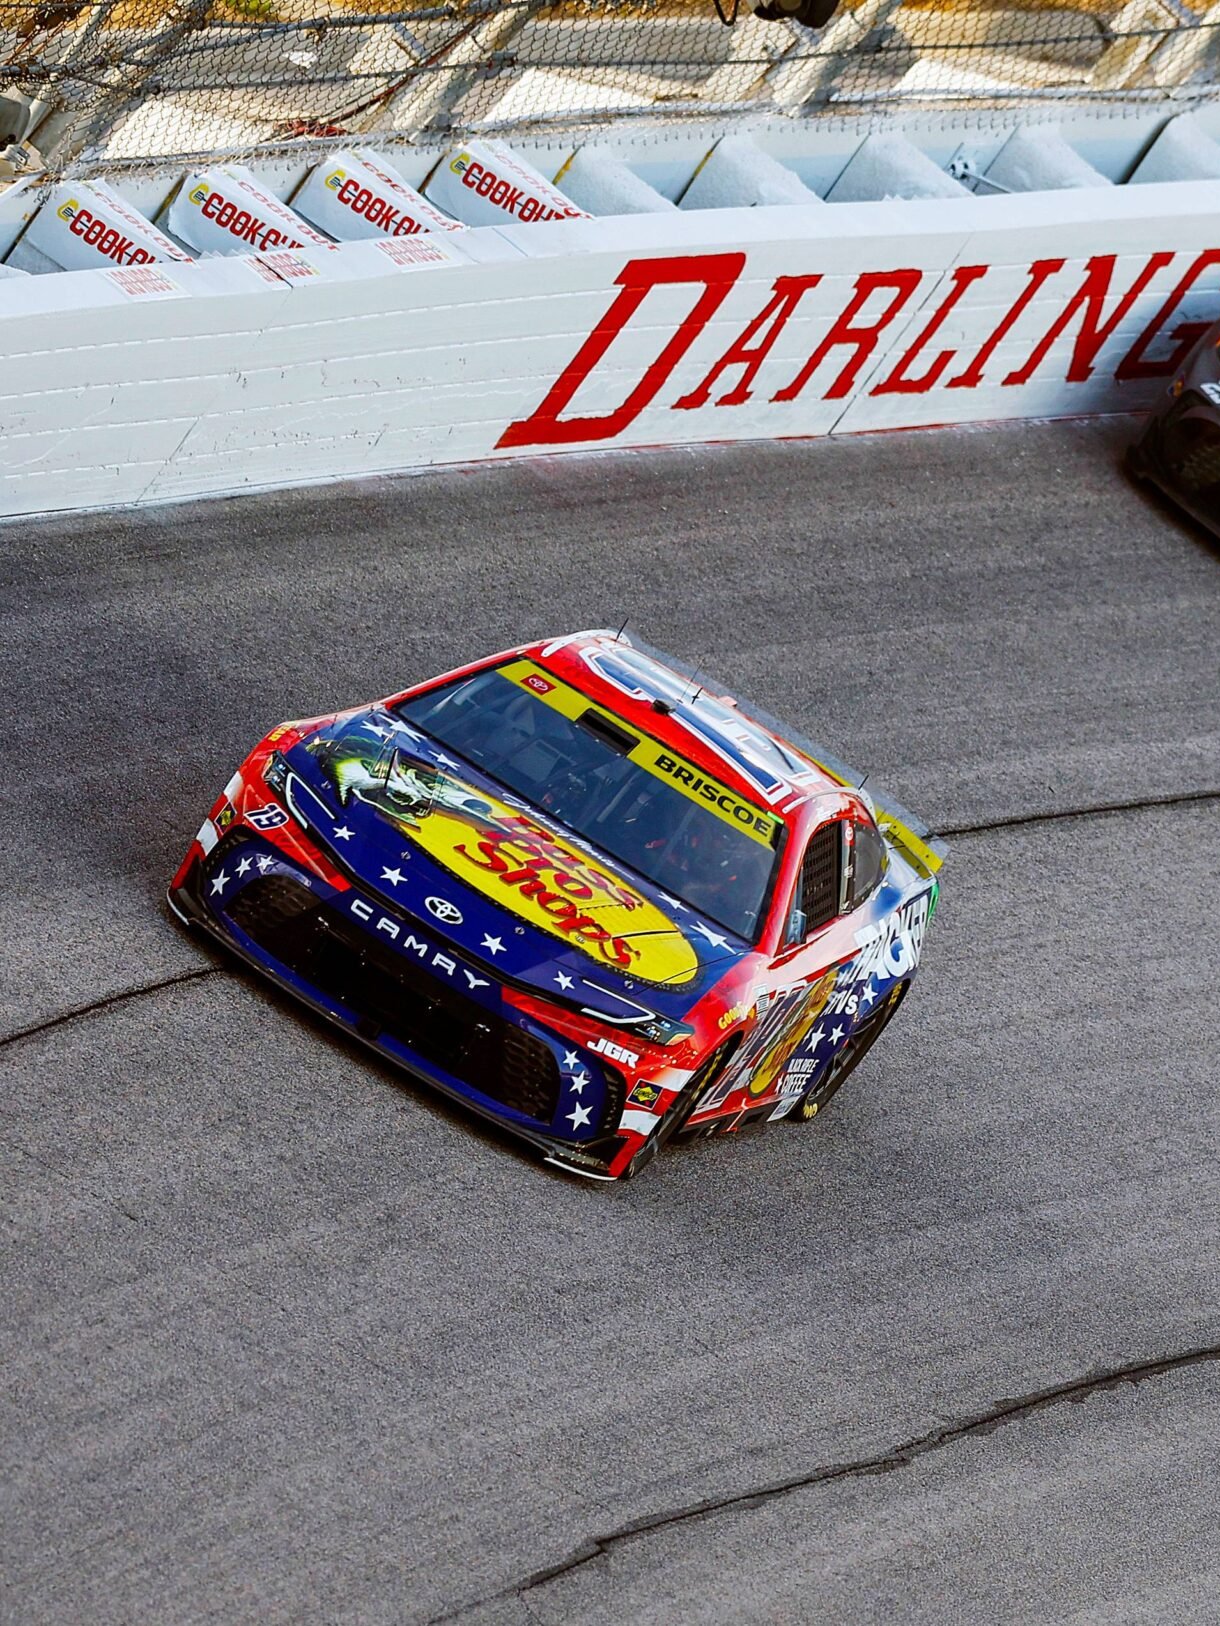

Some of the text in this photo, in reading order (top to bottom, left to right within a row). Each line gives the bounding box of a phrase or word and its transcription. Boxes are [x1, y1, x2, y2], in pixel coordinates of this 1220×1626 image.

[361, 161, 416, 202] COOK
[462, 162, 524, 214] COOK
[495, 154, 550, 194] COOK
[95, 192, 151, 235] COOK
[201, 192, 266, 246] COOK
[238, 181, 295, 222] COOK
[337, 179, 400, 232] COOK
[69, 209, 134, 265] COOK
[243, 802, 290, 831] 19
[653, 754, 773, 837] BRISCOE
[476, 828, 594, 900] Pro
[490, 814, 645, 911] Bass
[453, 840, 643, 970] Shops
[350, 899, 491, 990] CAMRY
[586, 1037, 641, 1069] JGR
